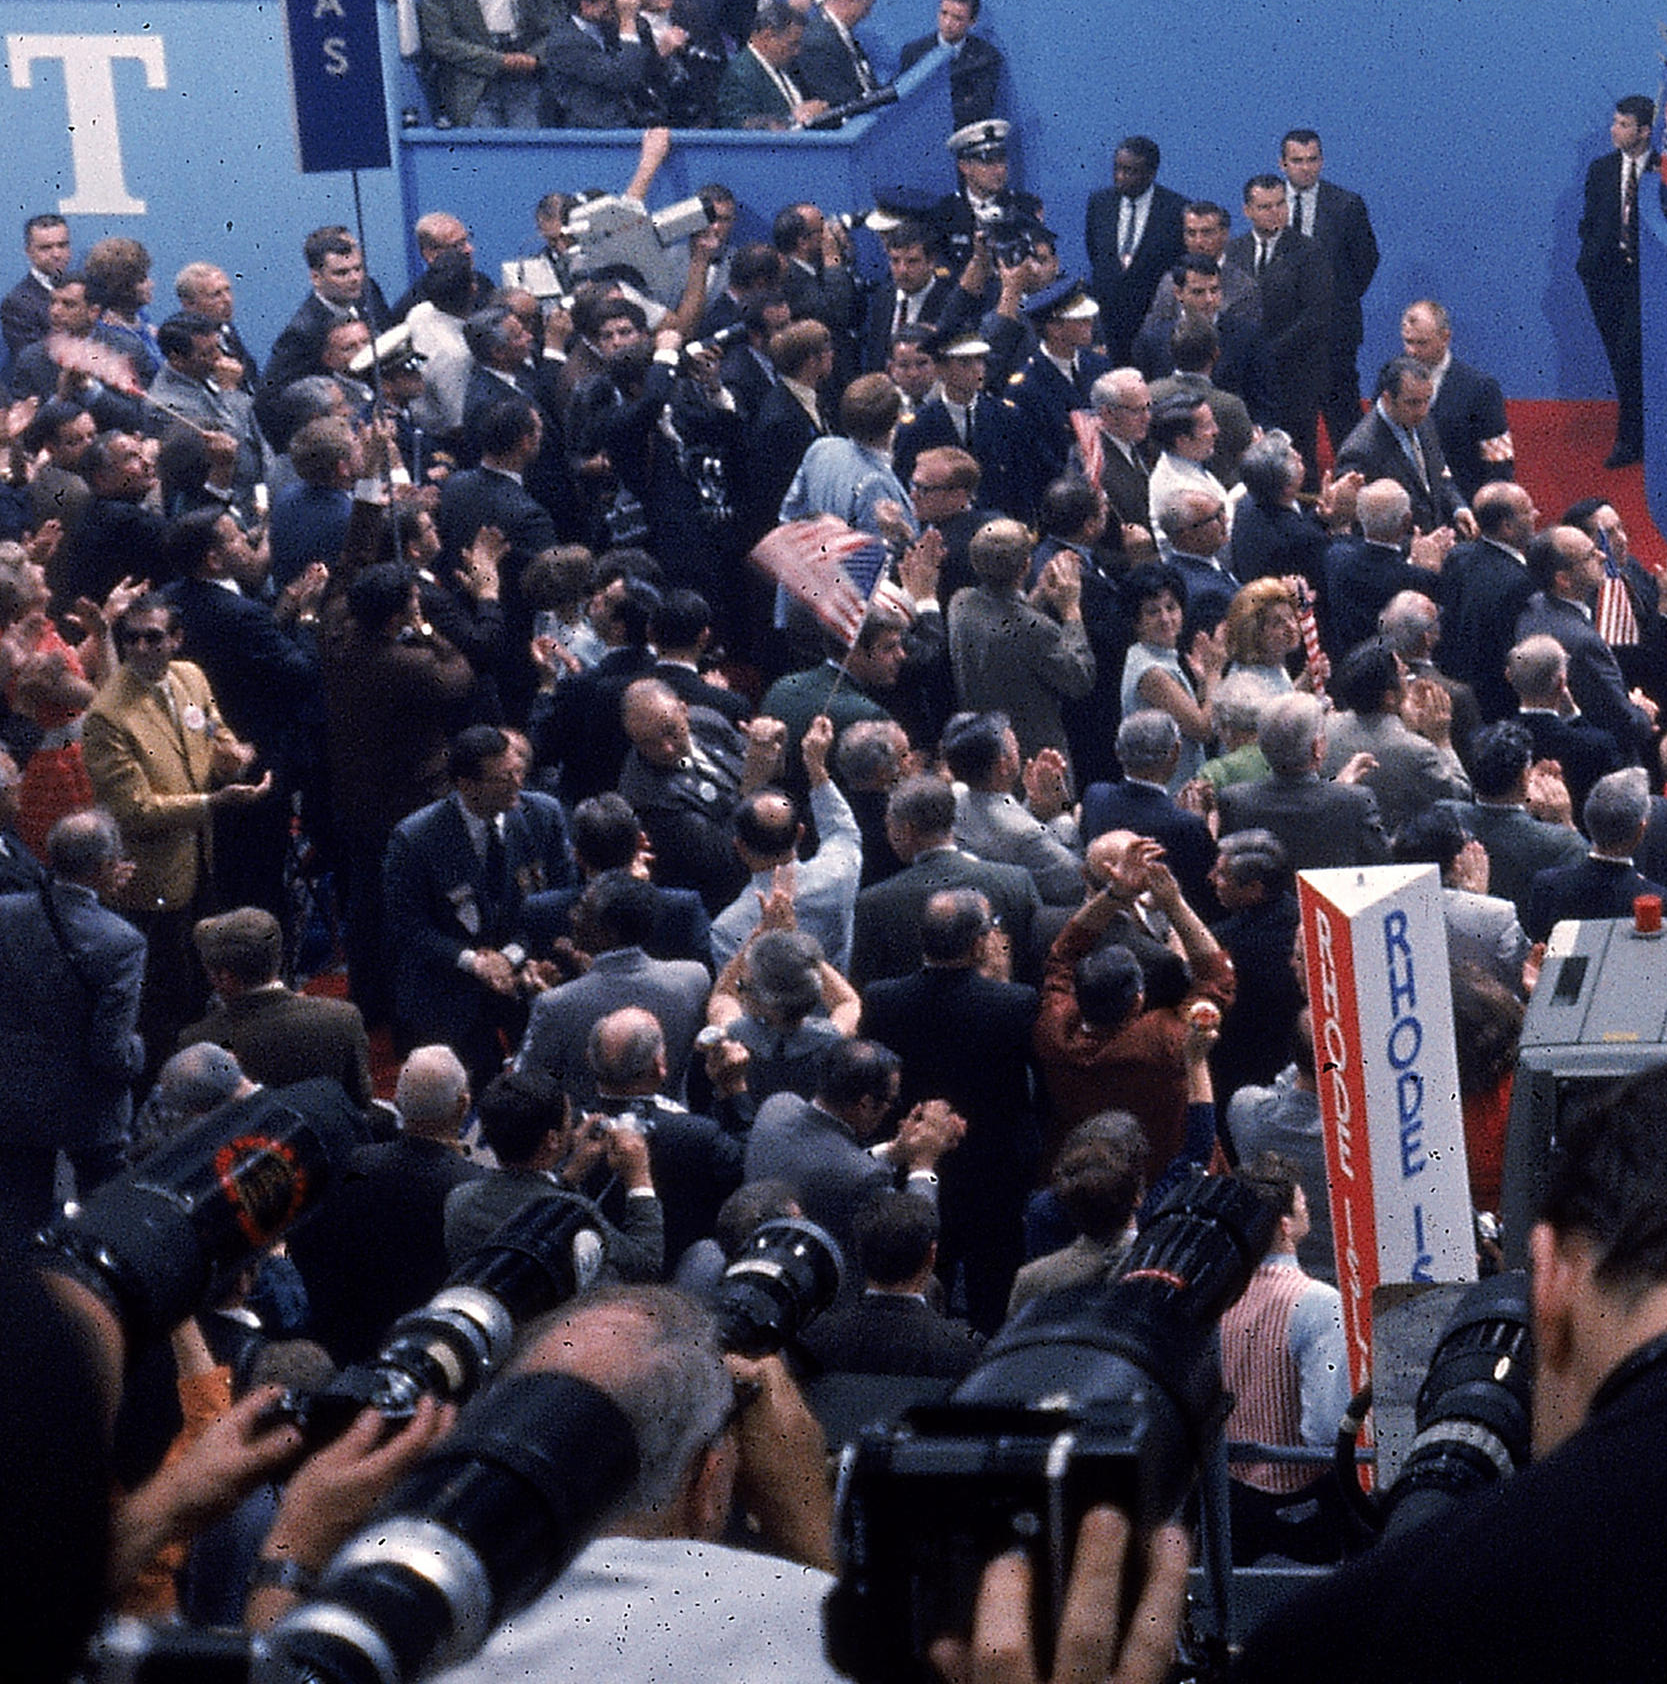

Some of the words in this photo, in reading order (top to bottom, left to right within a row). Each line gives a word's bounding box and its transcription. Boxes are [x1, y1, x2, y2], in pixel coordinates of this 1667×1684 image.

[7, 34, 168, 215] T
[1314, 906, 1354, 1179] RHODE
[1383, 909, 1427, 1178] RHODE
